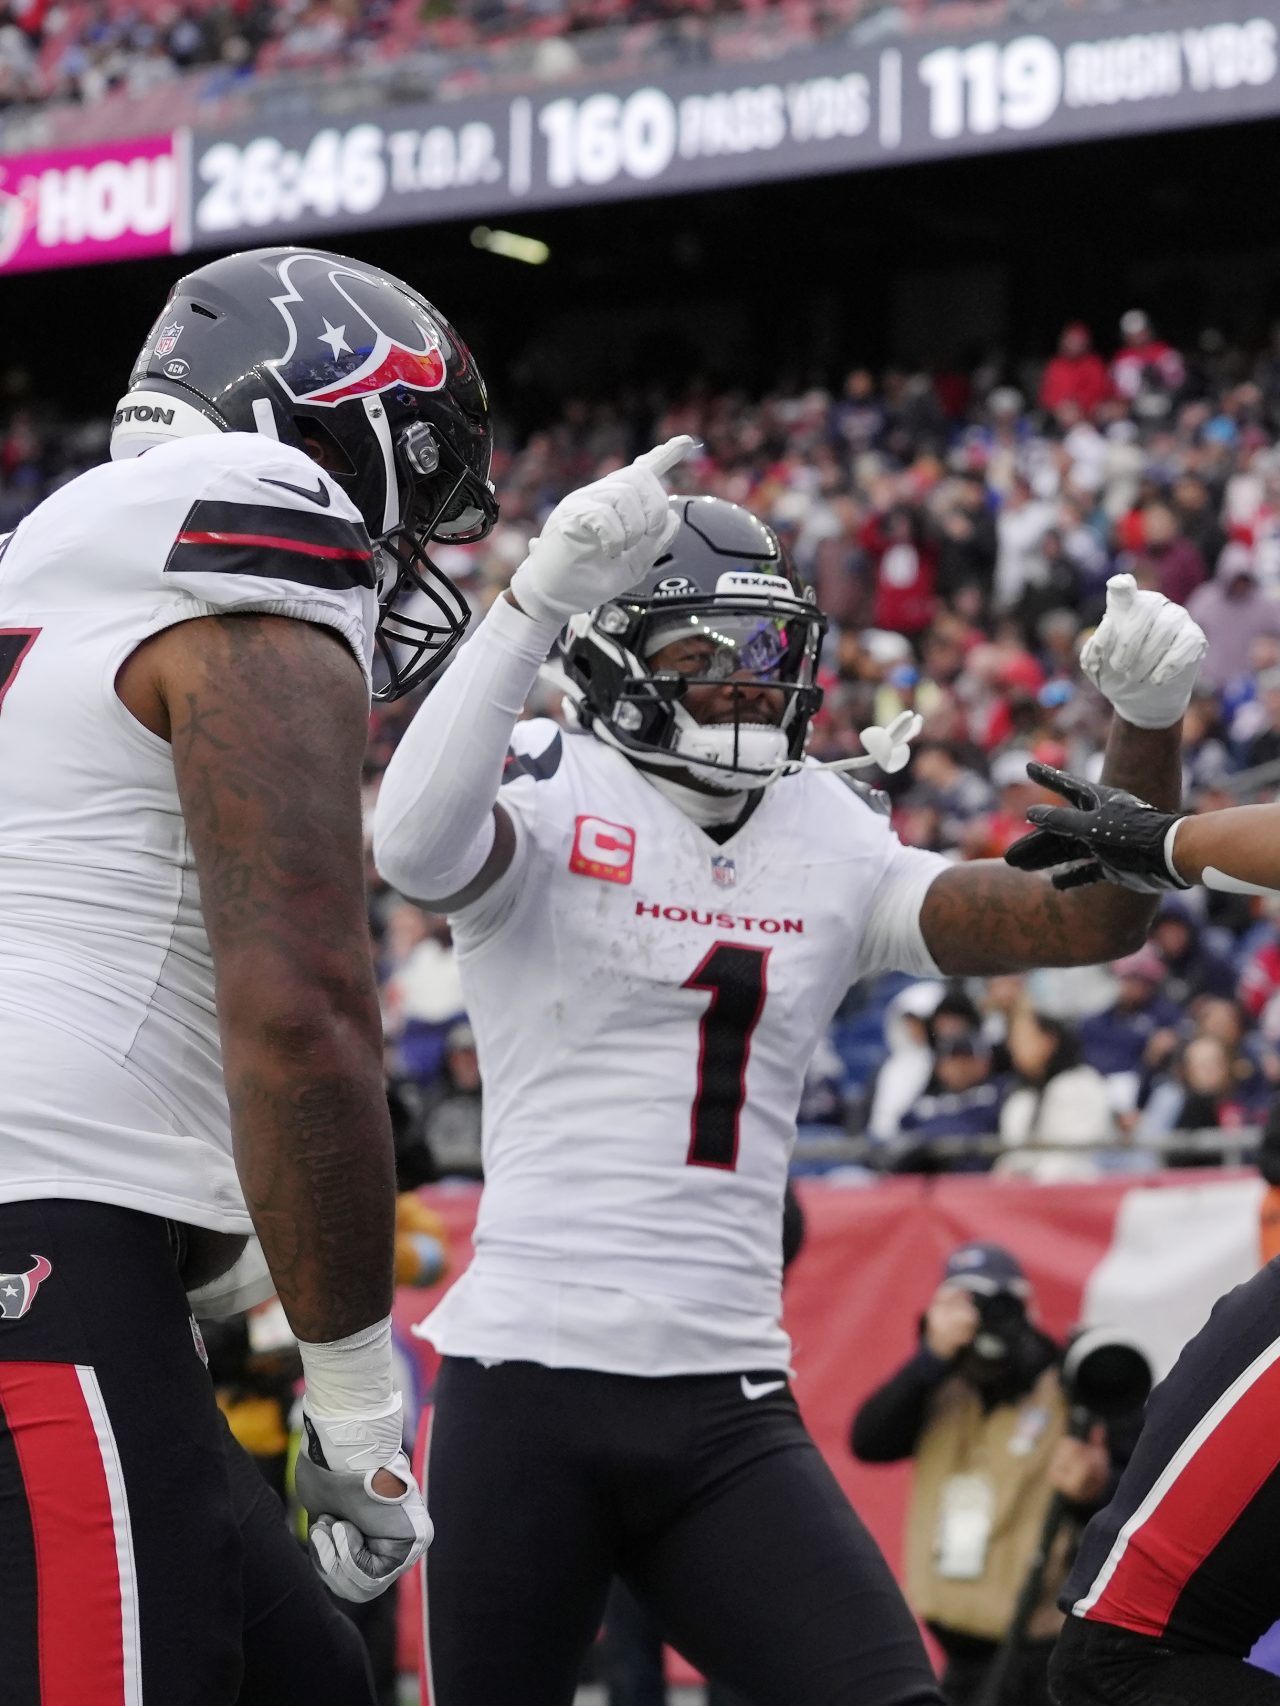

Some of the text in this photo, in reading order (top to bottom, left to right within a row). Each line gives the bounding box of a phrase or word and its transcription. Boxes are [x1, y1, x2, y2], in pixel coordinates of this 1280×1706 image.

[918, 35, 1062, 138] 119
[197, 124, 386, 231] 26:46
[538, 87, 676, 188] 160
[38, 153, 176, 247] HOU
[578, 817, 632, 867] C
[635, 901, 804, 933] HOUSTON
[680, 940, 773, 1172] 1
